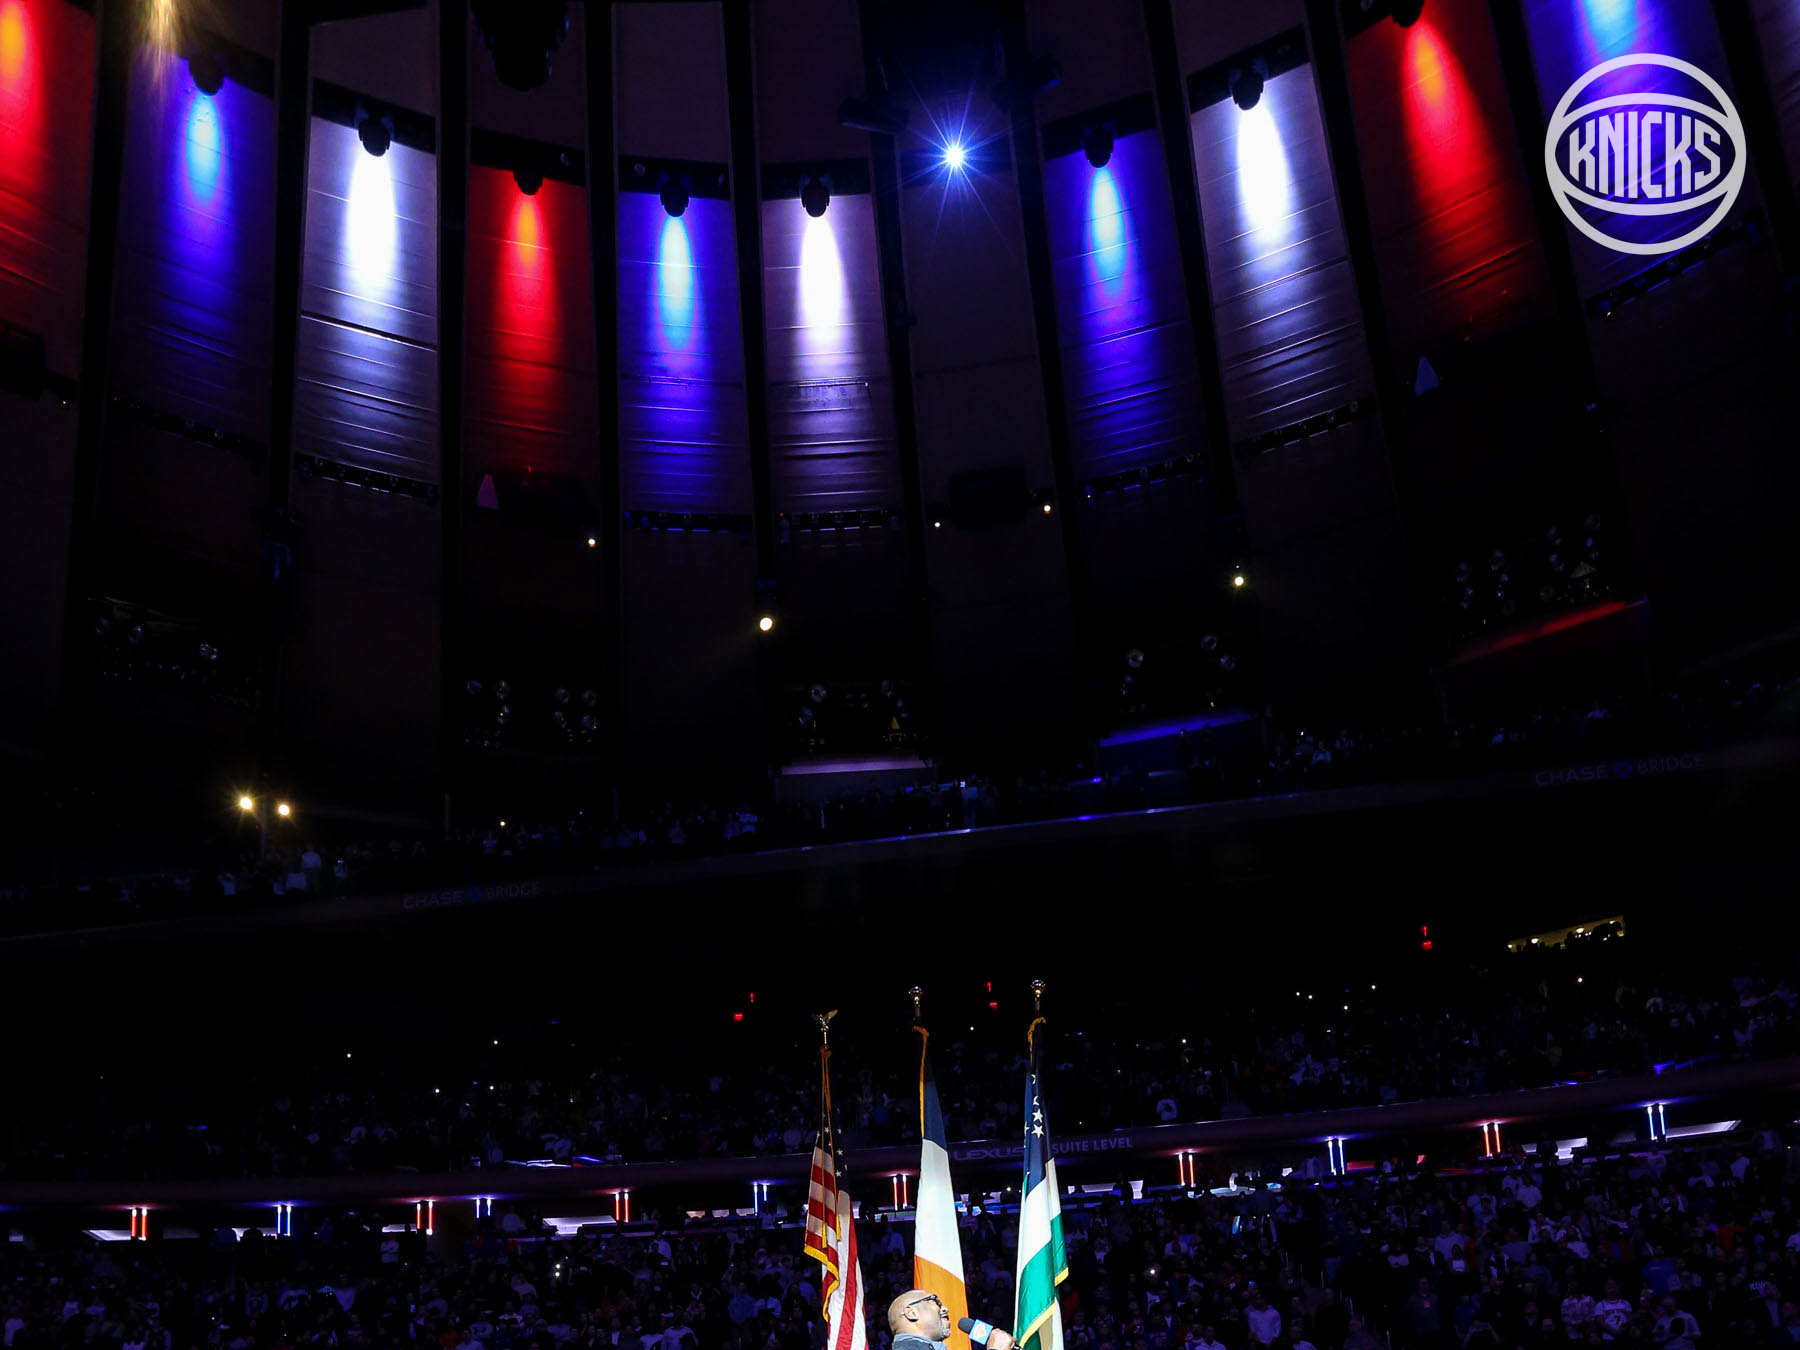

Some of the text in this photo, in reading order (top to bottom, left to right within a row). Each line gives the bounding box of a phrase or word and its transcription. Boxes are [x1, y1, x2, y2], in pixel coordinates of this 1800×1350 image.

[1536, 753, 1704, 788] CHASE BRIDGE
[401, 880, 544, 912] CHASE BRIDGE
[952, 1135, 1135, 1160] LEXUS SUITE LEVEL
